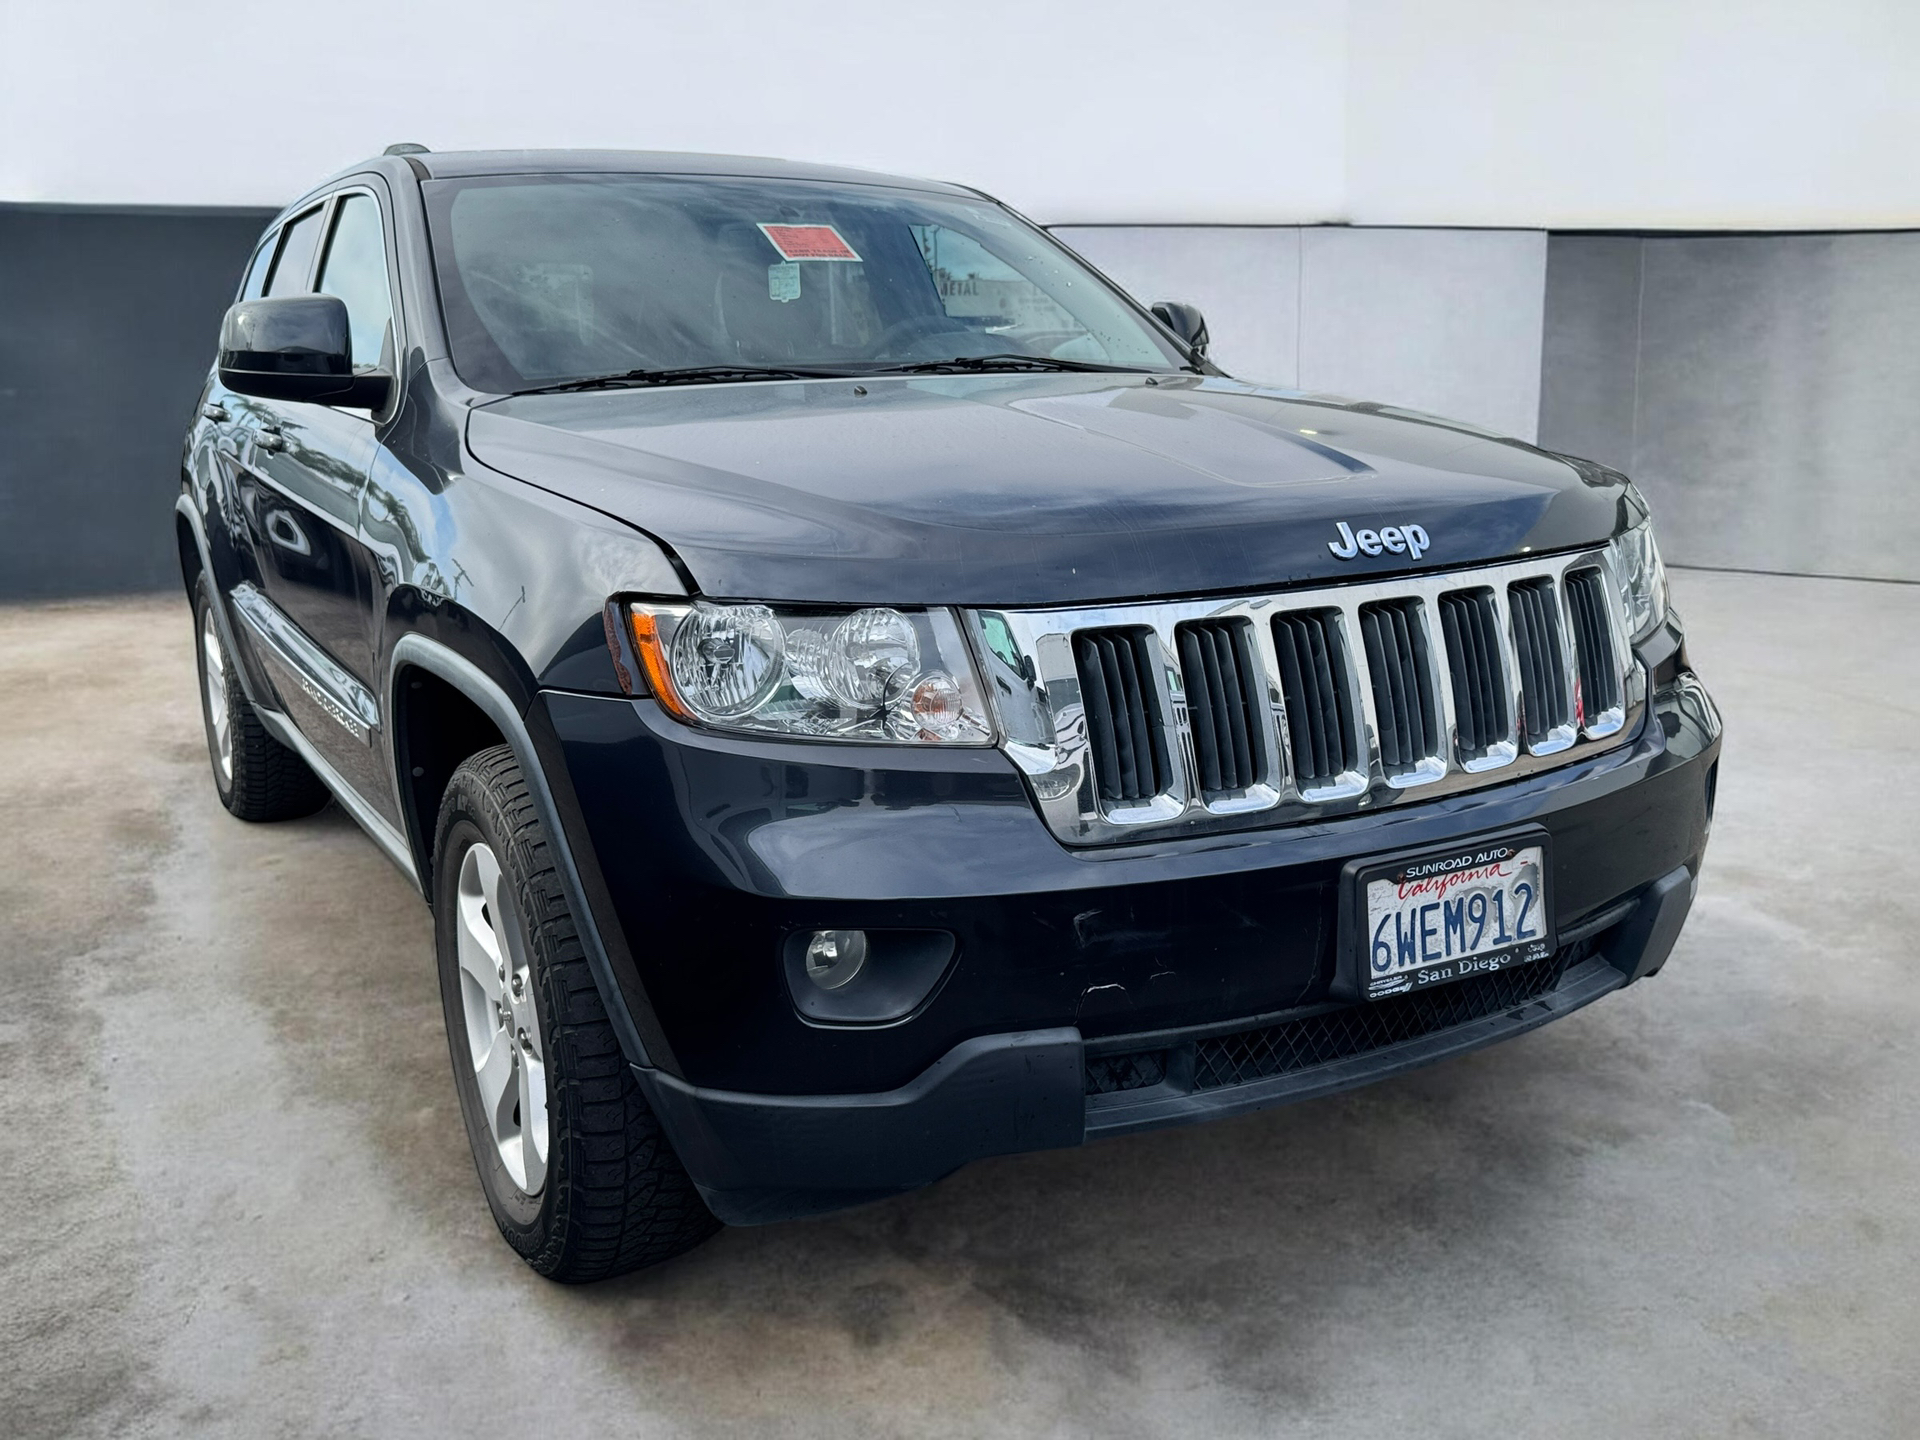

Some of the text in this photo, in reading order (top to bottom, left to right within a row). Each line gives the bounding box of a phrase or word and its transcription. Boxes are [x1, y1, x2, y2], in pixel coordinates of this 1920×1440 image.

[1328, 521, 1430, 560] Jeep
[1406, 855, 1472, 878] SUNROAD
[1475, 847, 1508, 864] AUTO
[1397, 863, 1512, 900] California
[1371, 882, 1537, 972] 6WEM912
[1417, 953, 1511, 984] San Diego
